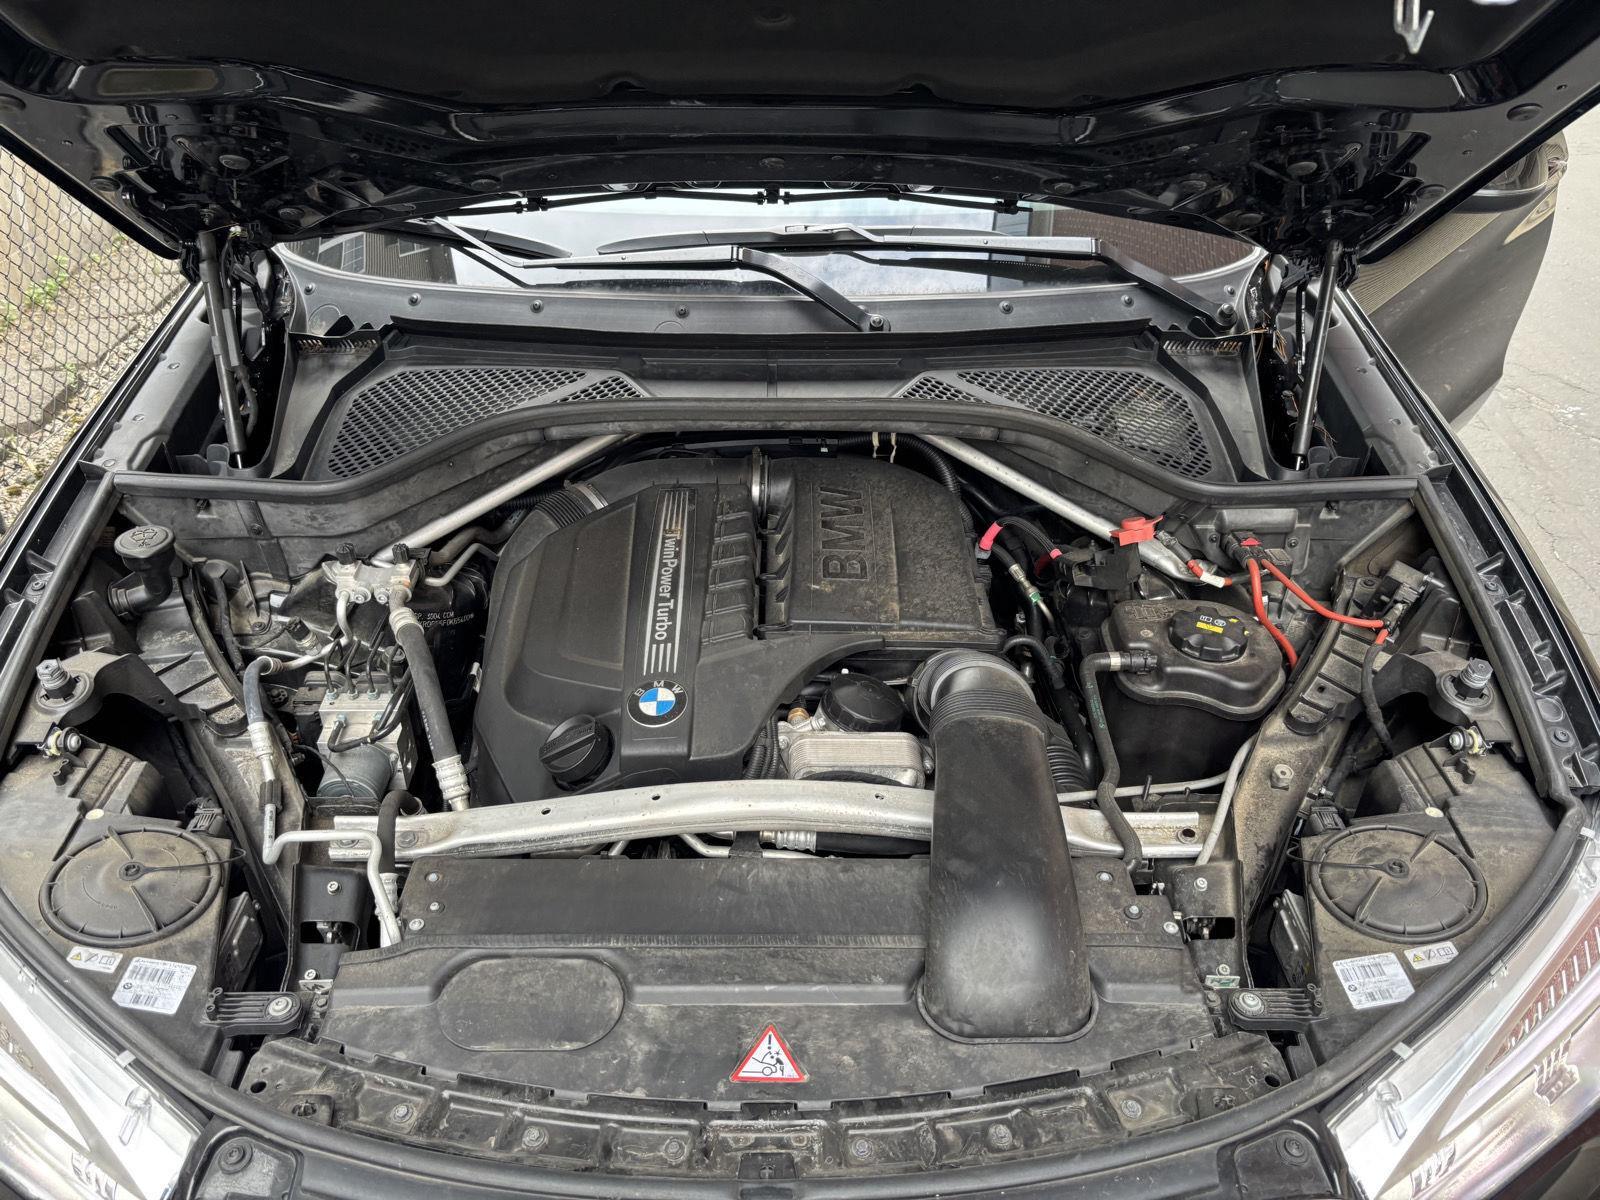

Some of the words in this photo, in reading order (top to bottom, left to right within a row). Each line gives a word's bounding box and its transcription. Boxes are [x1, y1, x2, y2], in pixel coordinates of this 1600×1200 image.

[820, 486, 868, 580] BMW
[659, 529, 682, 598] TwinPower
[654, 599, 675, 640] Turbo
[634, 680, 684, 697] BMW
